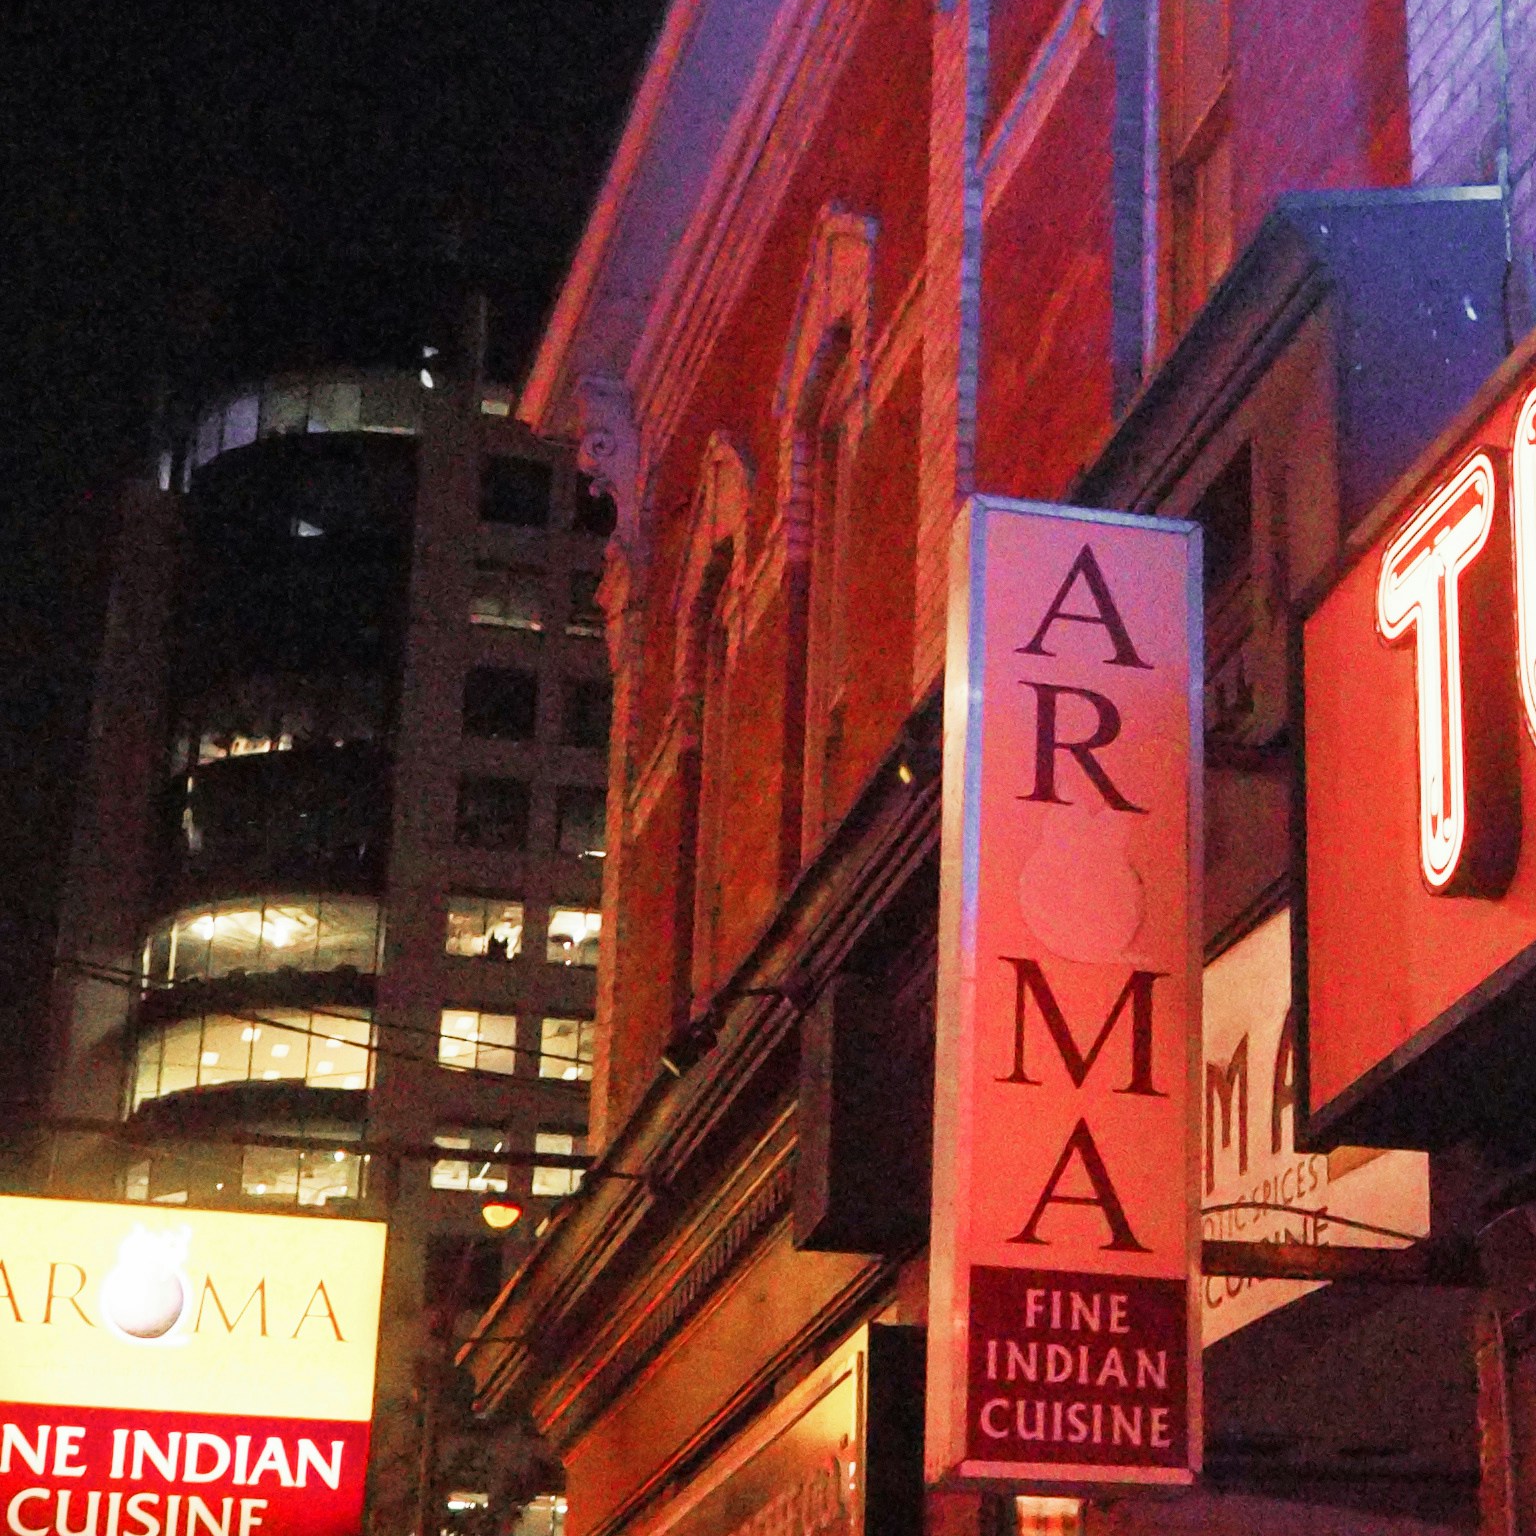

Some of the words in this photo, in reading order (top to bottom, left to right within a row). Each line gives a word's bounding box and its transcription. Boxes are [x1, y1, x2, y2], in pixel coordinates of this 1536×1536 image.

[1026, 1288, 1130, 1333] FINE
[987, 1340, 1167, 1388] INDIAN
[980, 1398, 1171, 1448] CUISINE
[109, 1429, 344, 1489] INDIAN
